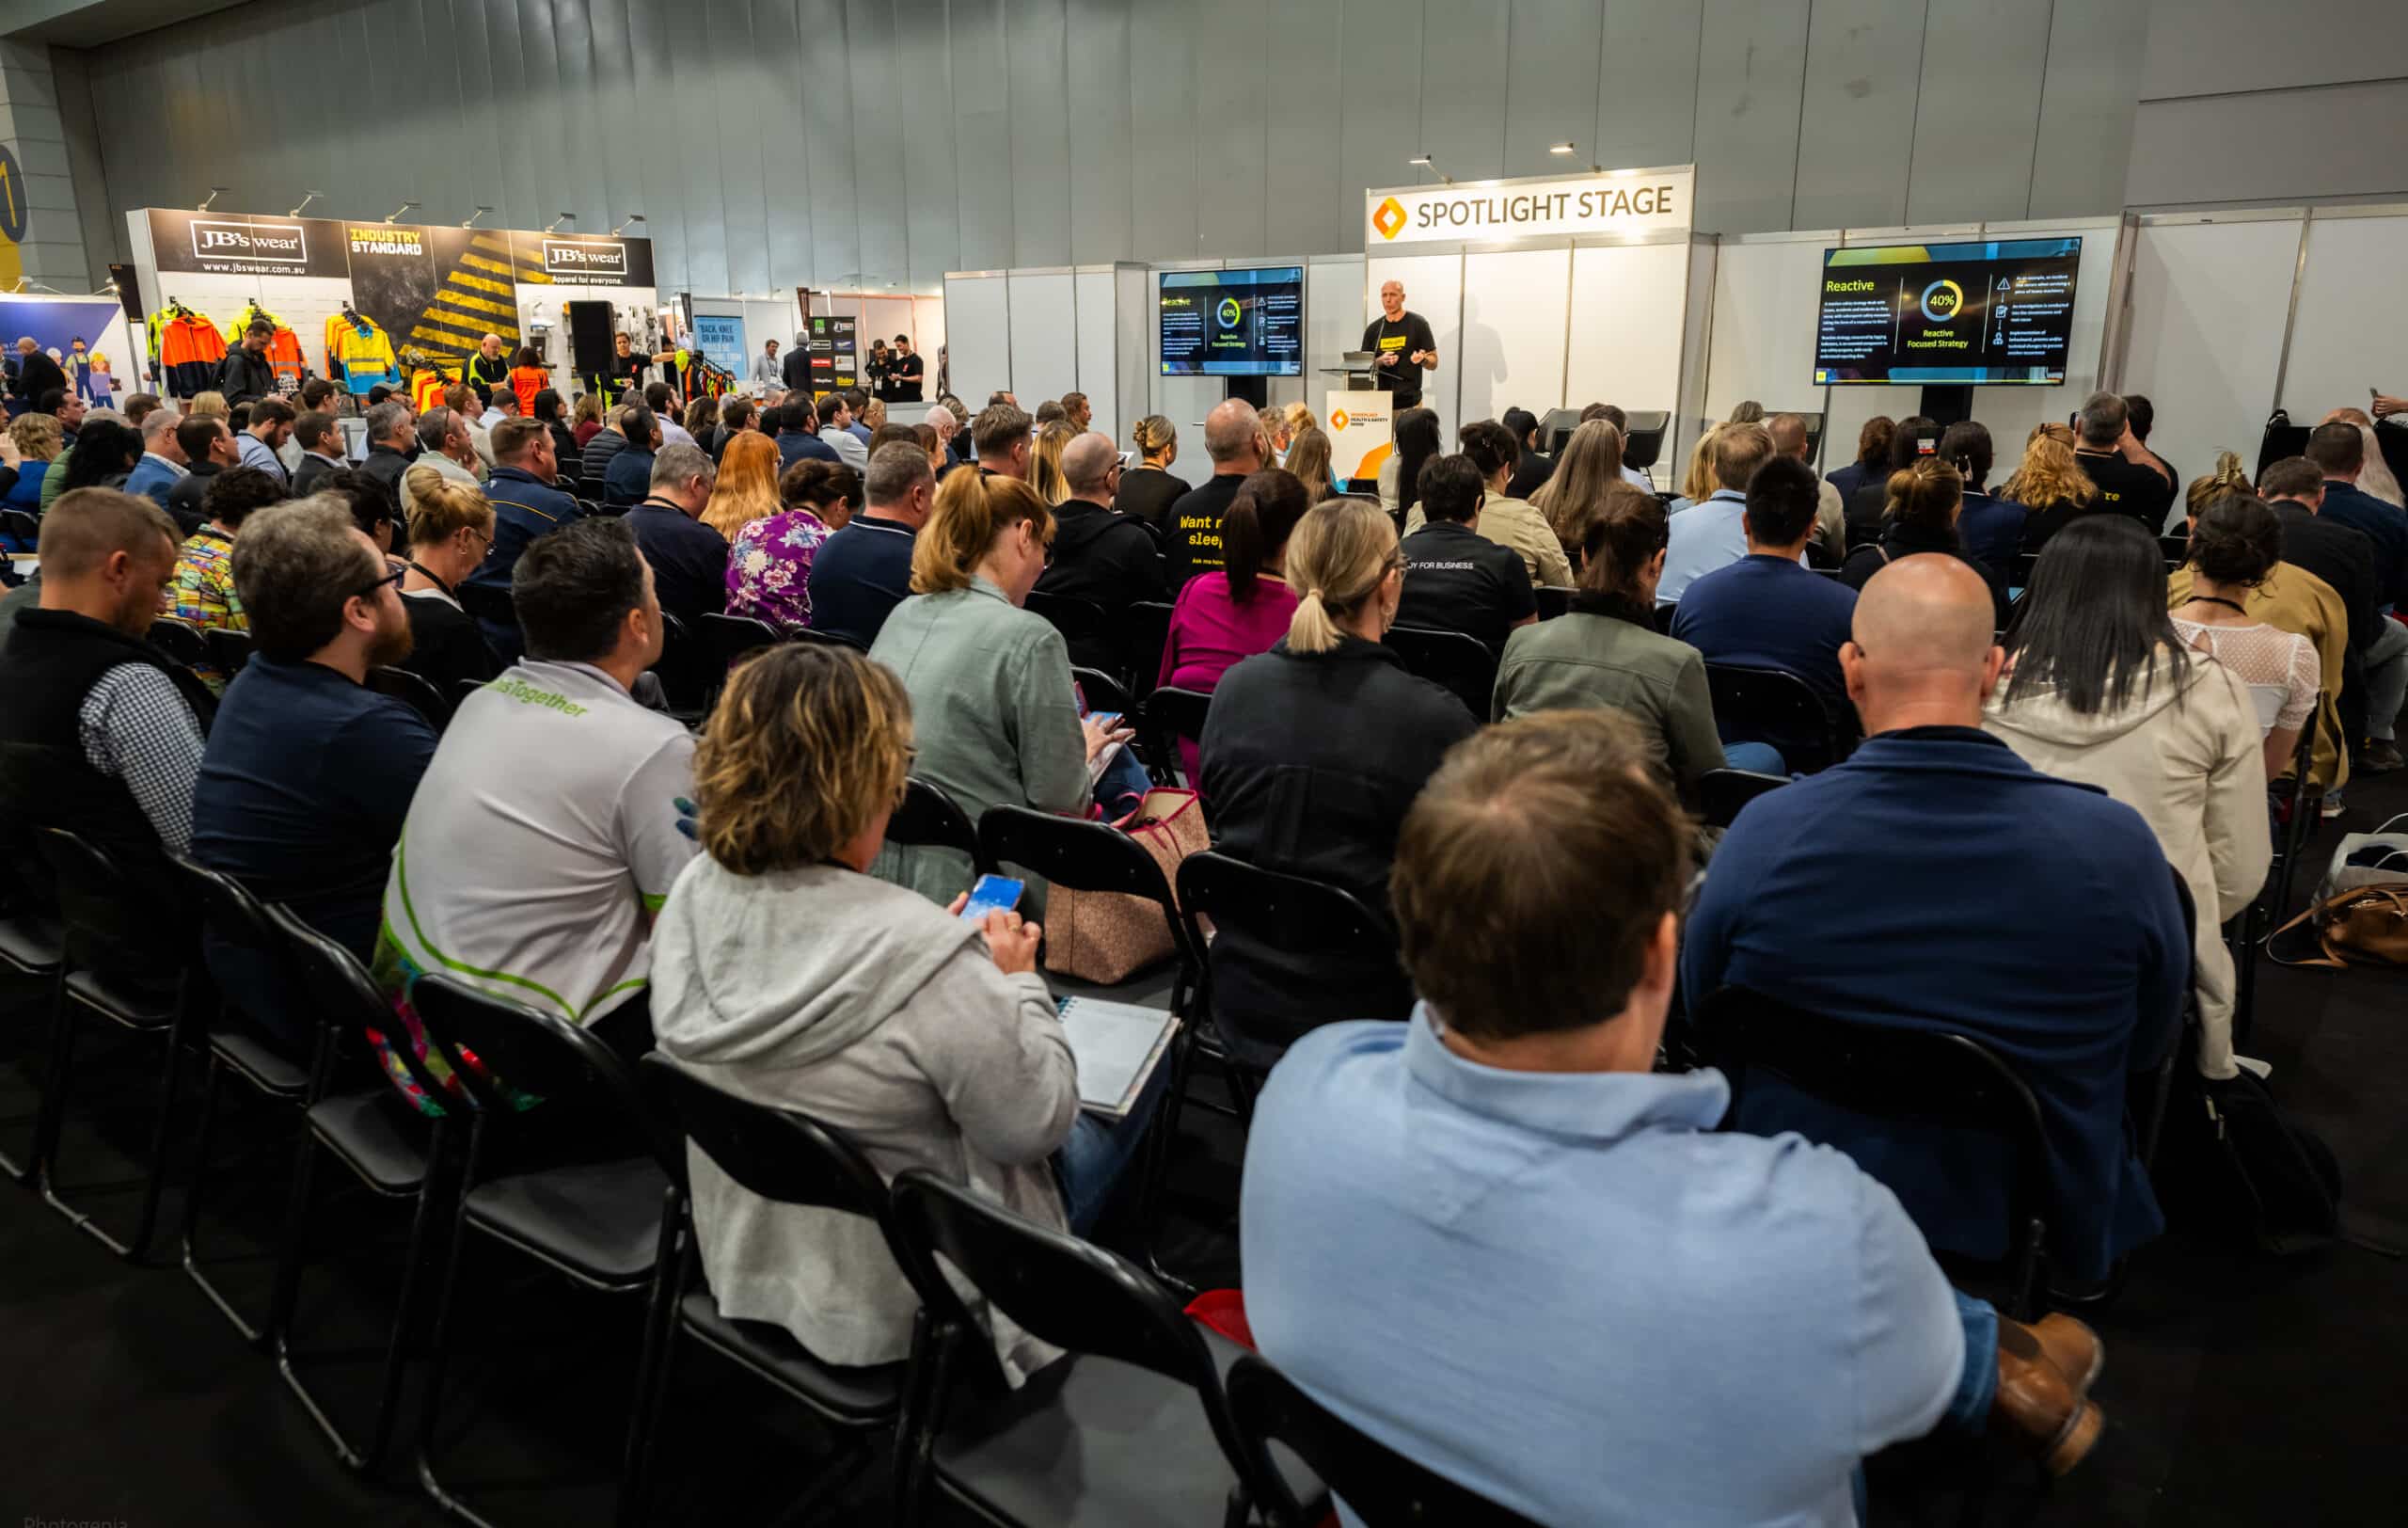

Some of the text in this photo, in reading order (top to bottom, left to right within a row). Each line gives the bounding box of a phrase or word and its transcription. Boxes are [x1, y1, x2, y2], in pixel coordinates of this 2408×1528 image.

[1417, 185, 1674, 228] SPOTLIGHT STAGE
[200, 231, 298, 249] JB's wear
[350, 228, 421, 244] INDUSTRY
[351, 241, 422, 256] STANDARD
[549, 247, 622, 264] JB's wear
[202, 263, 306, 275] www.jbswear.com.au
[1826, 279, 1875, 293] Reactive
[1929, 294, 1956, 307] 40%
[1222, 309, 1237, 318] 40%
[1923, 329, 1955, 338] Reactive
[1907, 339, 1969, 349] Focused Strategy
[1180, 516, 1212, 529] Want
[1418, 561, 1435, 570] FOR
[1435, 561, 1475, 570] BUSINESS
